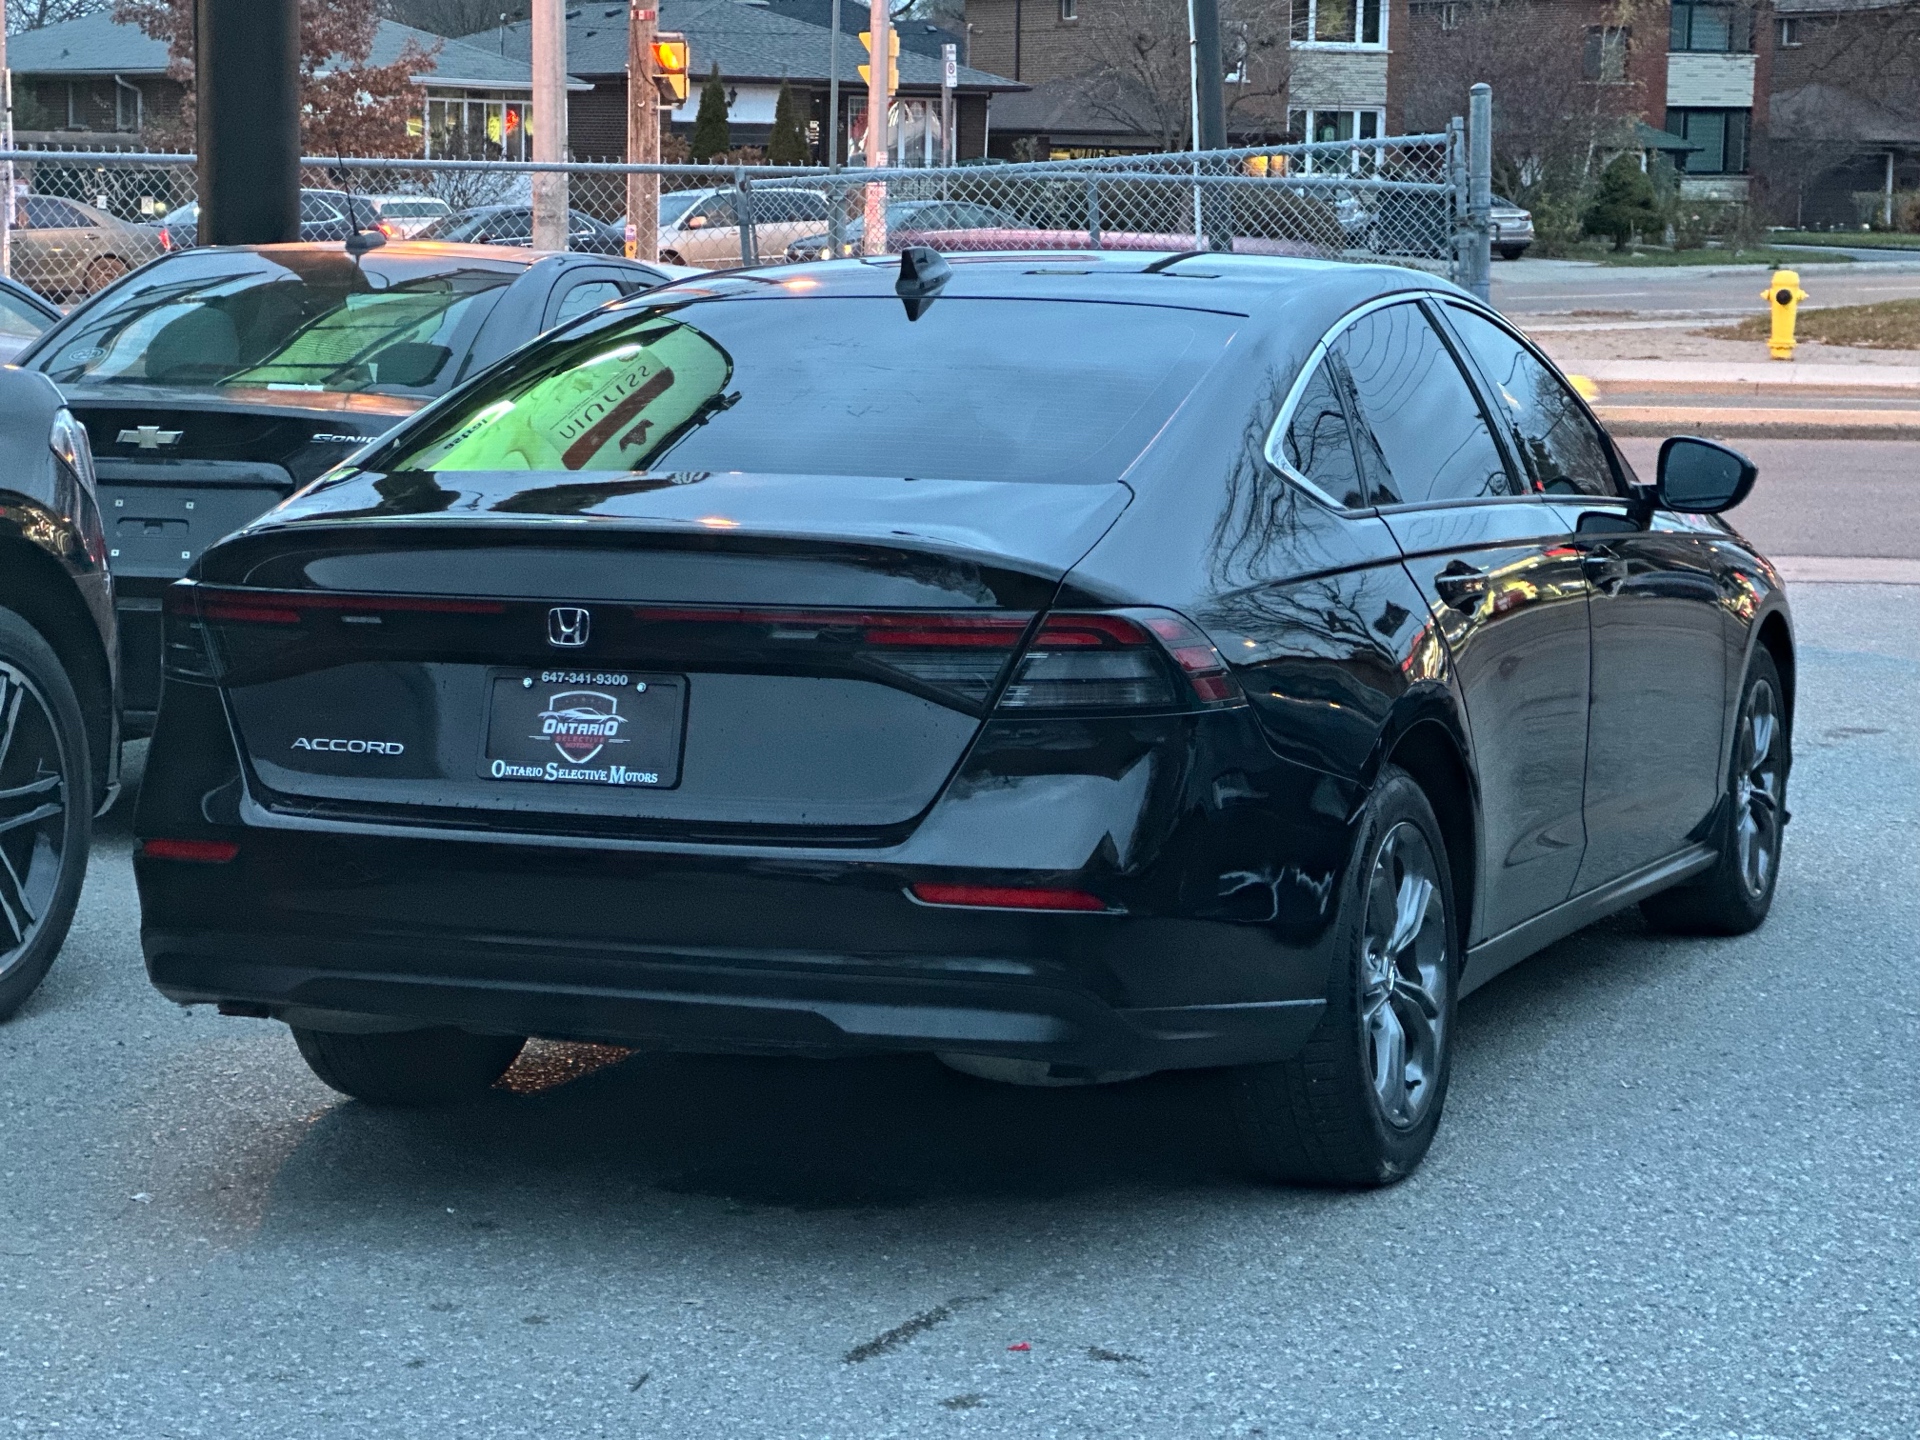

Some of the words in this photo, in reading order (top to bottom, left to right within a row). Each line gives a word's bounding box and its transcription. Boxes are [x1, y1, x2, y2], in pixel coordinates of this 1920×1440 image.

[541, 671, 629, 686] 647-341-9300
[542, 718, 619, 736] ONTARIO
[290, 737, 404, 755] ACCORD
[555, 735, 605, 744] SELECTIVE
[491, 759, 543, 778] ONTARIO
[544, 762, 607, 781] SELECTIVE
[608, 765, 658, 784] MOTORS
